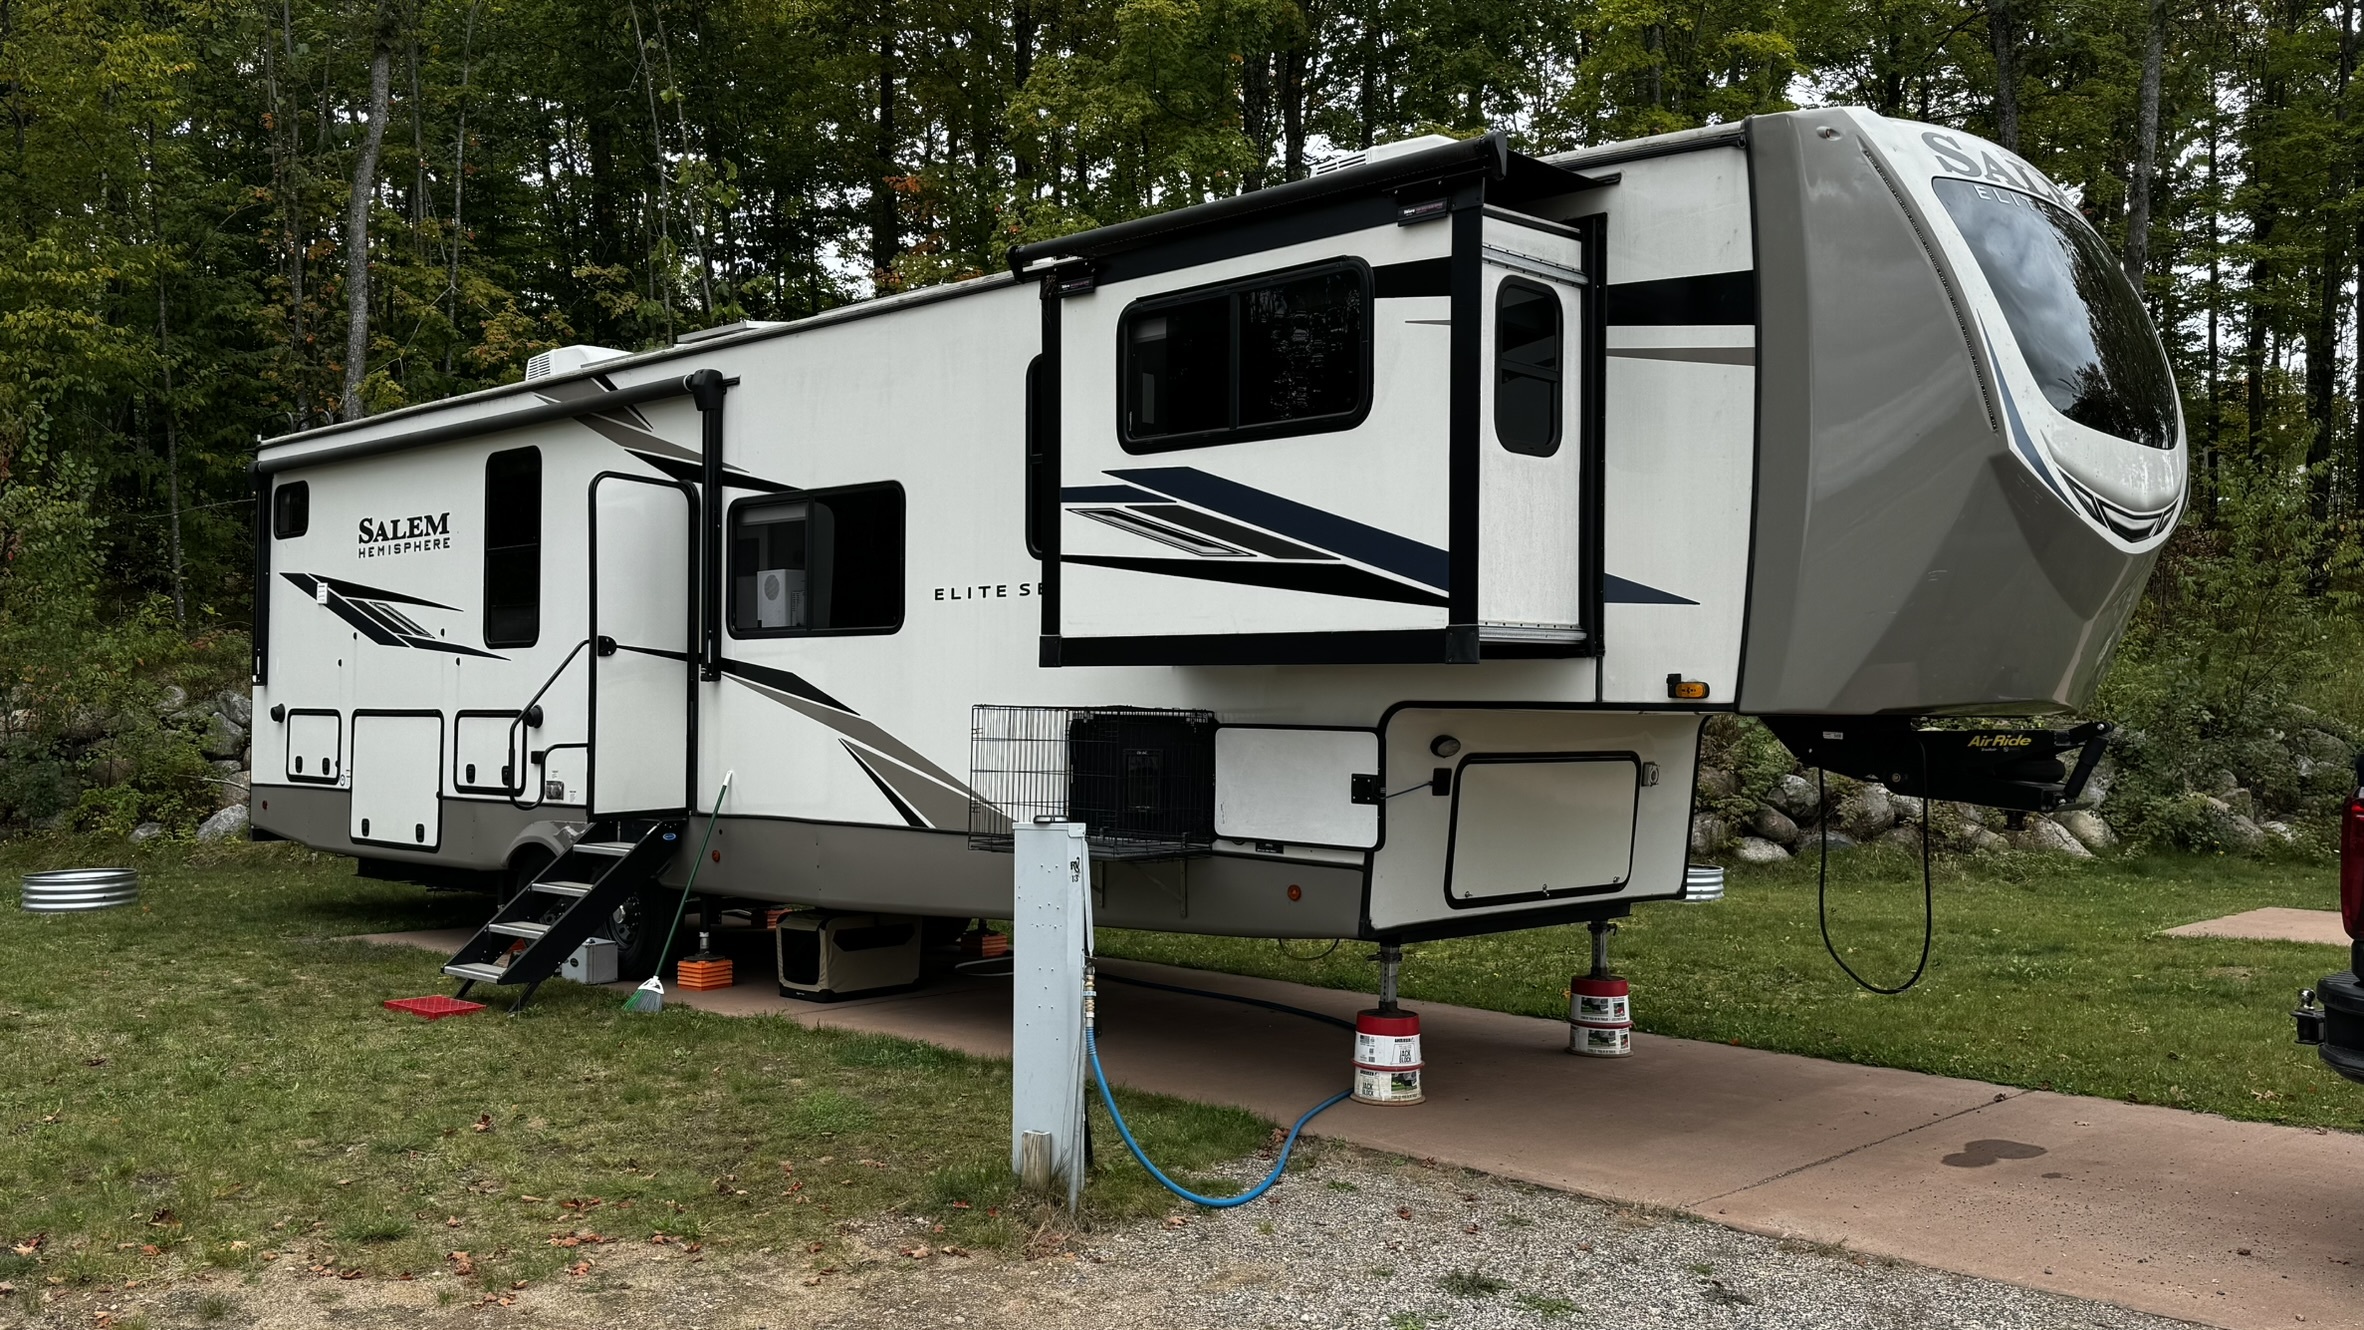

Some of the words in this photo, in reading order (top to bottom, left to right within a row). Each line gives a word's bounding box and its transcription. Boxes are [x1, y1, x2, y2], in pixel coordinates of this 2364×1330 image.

[1973, 184, 2051, 217] ELITE
[358, 512, 450, 545] SALEM
[358, 537, 450, 559] HEMISPHERE
[934, 585, 1007, 601] ELITE
